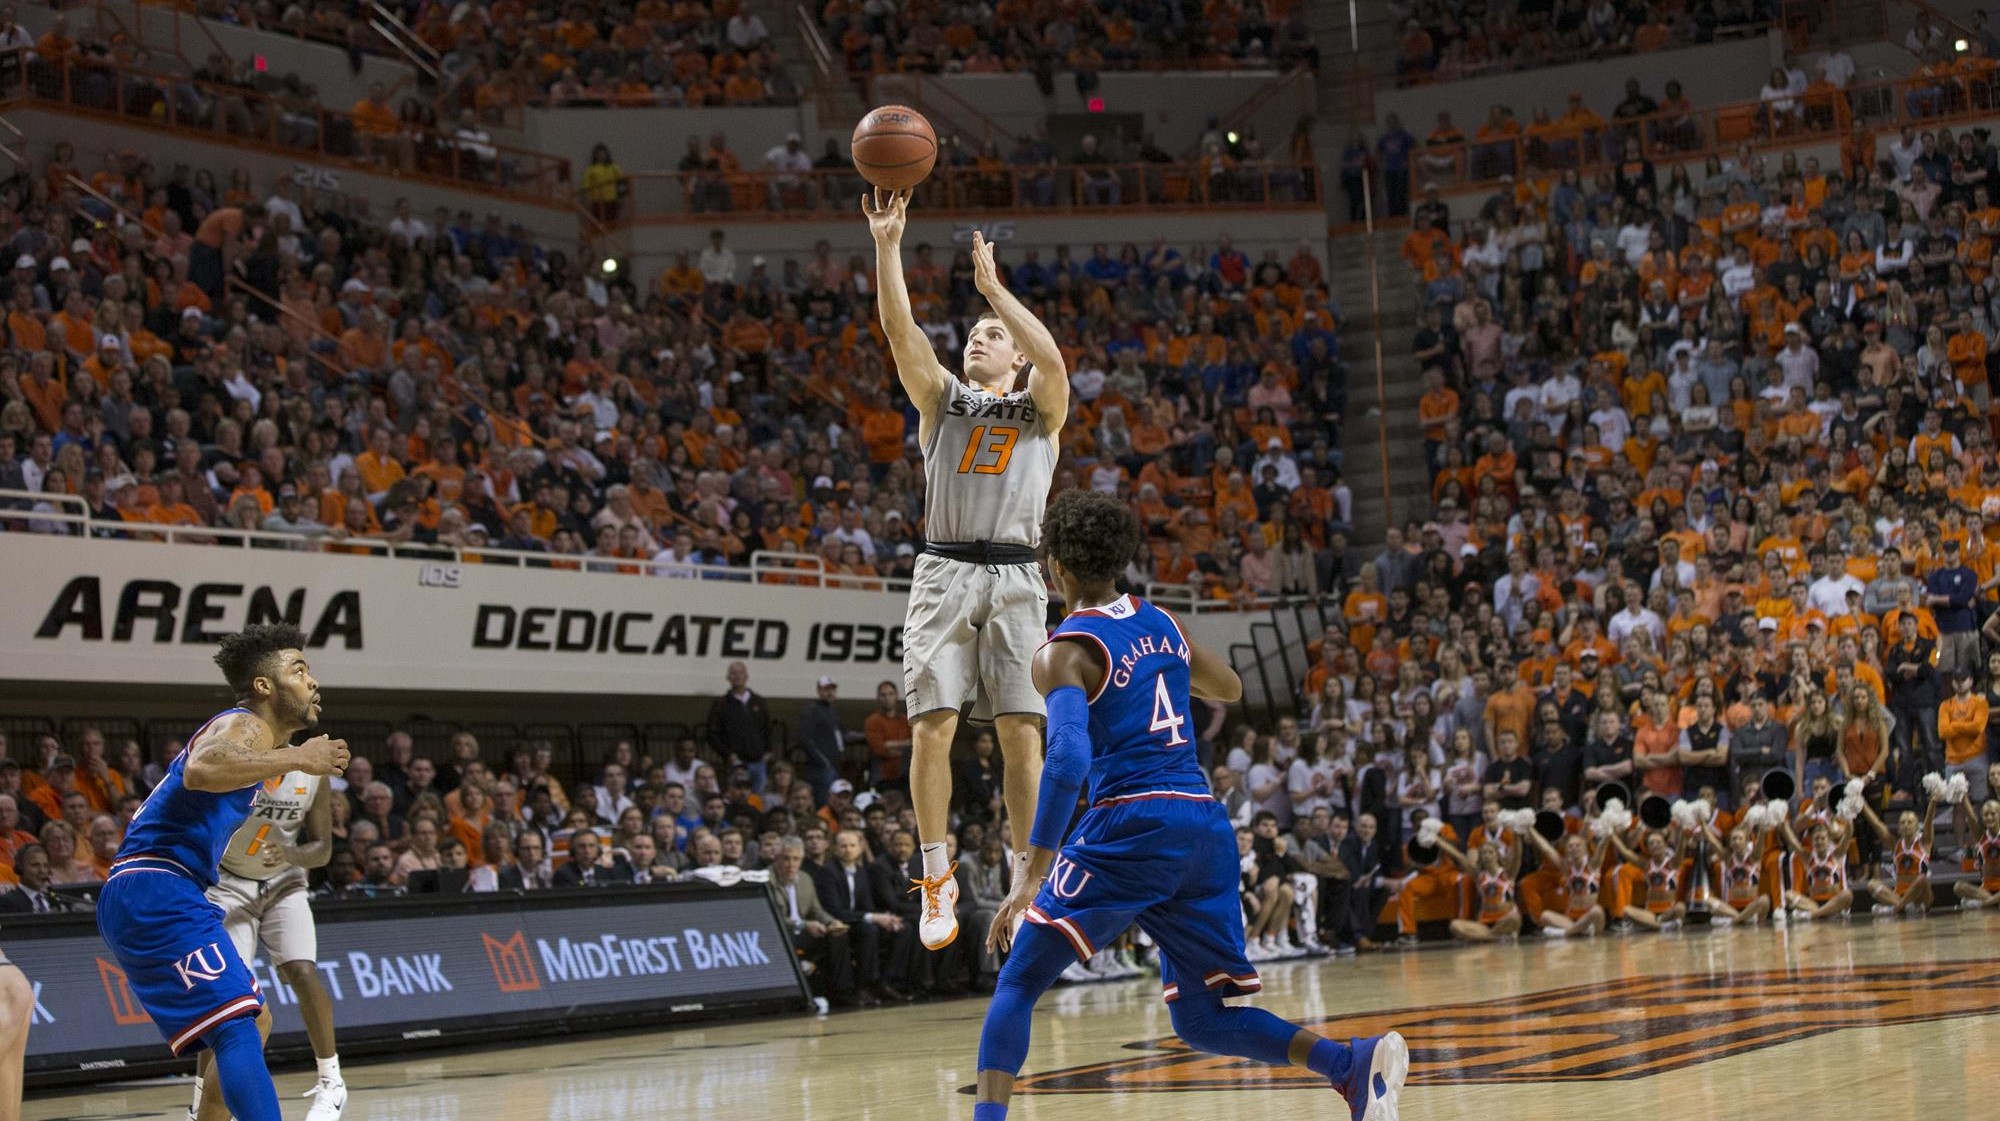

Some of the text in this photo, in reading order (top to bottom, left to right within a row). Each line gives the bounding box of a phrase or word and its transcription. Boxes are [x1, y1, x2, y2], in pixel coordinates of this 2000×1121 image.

[946, 400, 1034, 422] STATE
[961, 394, 1030, 408] OKAHOMA
[957, 425, 1019, 475] 13
[418, 565, 461, 588] 109
[33, 576, 905, 663] ARENA DEDICATED 1938
[1108, 603, 1126, 616] KU
[1113, 636, 1191, 689] GRAHAM
[1150, 671, 1188, 748] 4
[256, 805, 302, 820] ATE
[257, 798, 300, 807] AHOMA
[172, 943, 228, 992] KU
[347, 951, 453, 998] BANK
[536, 929, 770, 982] MIDFIRST BANK
